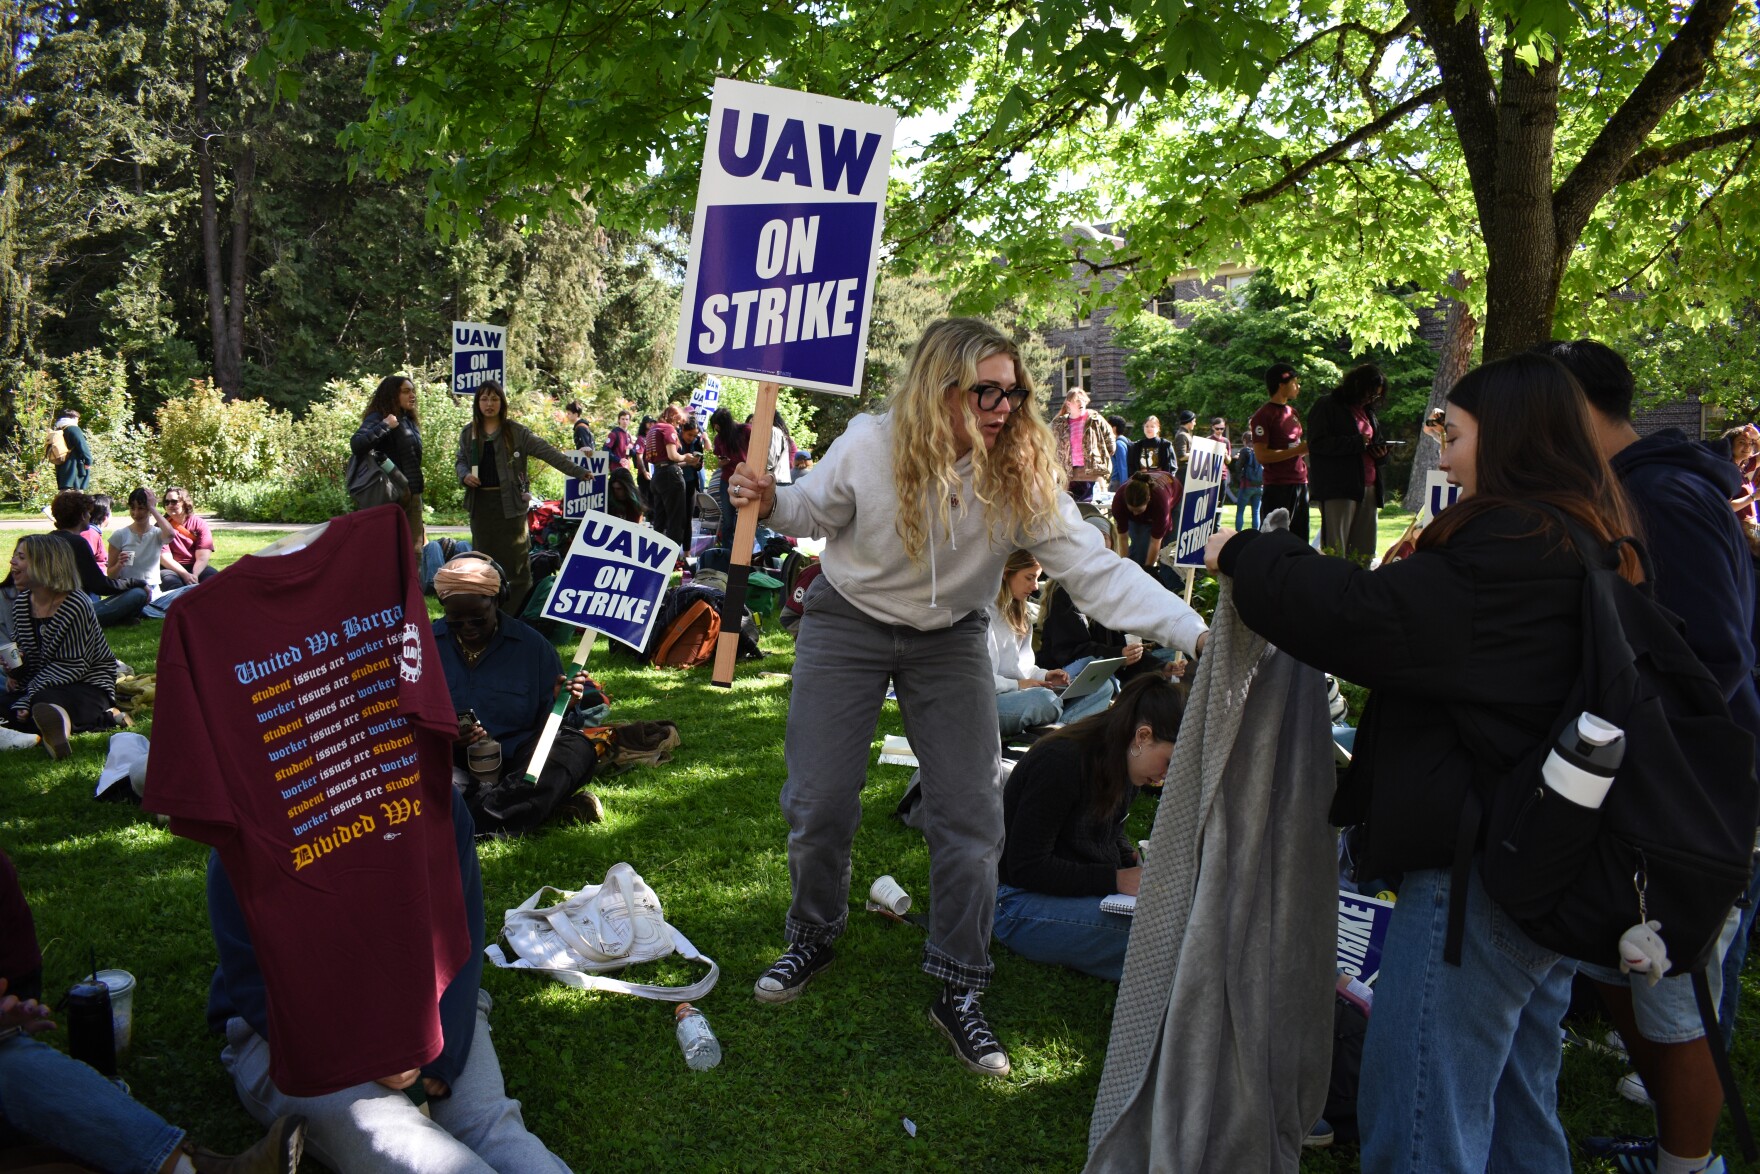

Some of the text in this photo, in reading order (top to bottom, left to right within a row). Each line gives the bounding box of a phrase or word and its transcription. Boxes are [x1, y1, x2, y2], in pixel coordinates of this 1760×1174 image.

[718, 108, 882, 196] UAW
[755, 215, 820, 280] ON
[456, 328, 502, 348] UAW
[698, 278, 858, 355] STRIKE
[470, 353, 488, 370] ON
[578, 480, 593, 496] ON
[1190, 449, 1223, 483] UAW
[566, 492, 604, 515] STRIKE
[1193, 493, 1210, 524] ON
[582, 520, 672, 569] UAW
[594, 565, 635, 592] ON
[554, 588, 651, 624] STRIKE
[235, 645, 303, 685] United
[305, 630, 340, 656] We
[252, 679, 292, 704] student
[293, 664, 328, 686] issues
[329, 656, 346, 671] are
[346, 638, 384, 662] worker
[256, 699, 297, 724] worker
[297, 684, 332, 706] issues
[333, 675, 350, 690] are
[351, 657, 391, 682] student
[263, 676, 397, 744] student issues are worker
[268, 737, 308, 762] worker
[309, 720, 343, 744] issues
[343, 712, 360, 728] are
[274, 755, 315, 782] student
[315, 739, 349, 762] issues
[349, 730, 367, 745] are
[281, 732, 415, 800] worker issues are student
[287, 751, 418, 819] student issues are worker
[291, 797, 423, 872] Divided We
[293, 811, 329, 837] worker
[330, 793, 363, 817] issues
[364, 785, 384, 800] are
